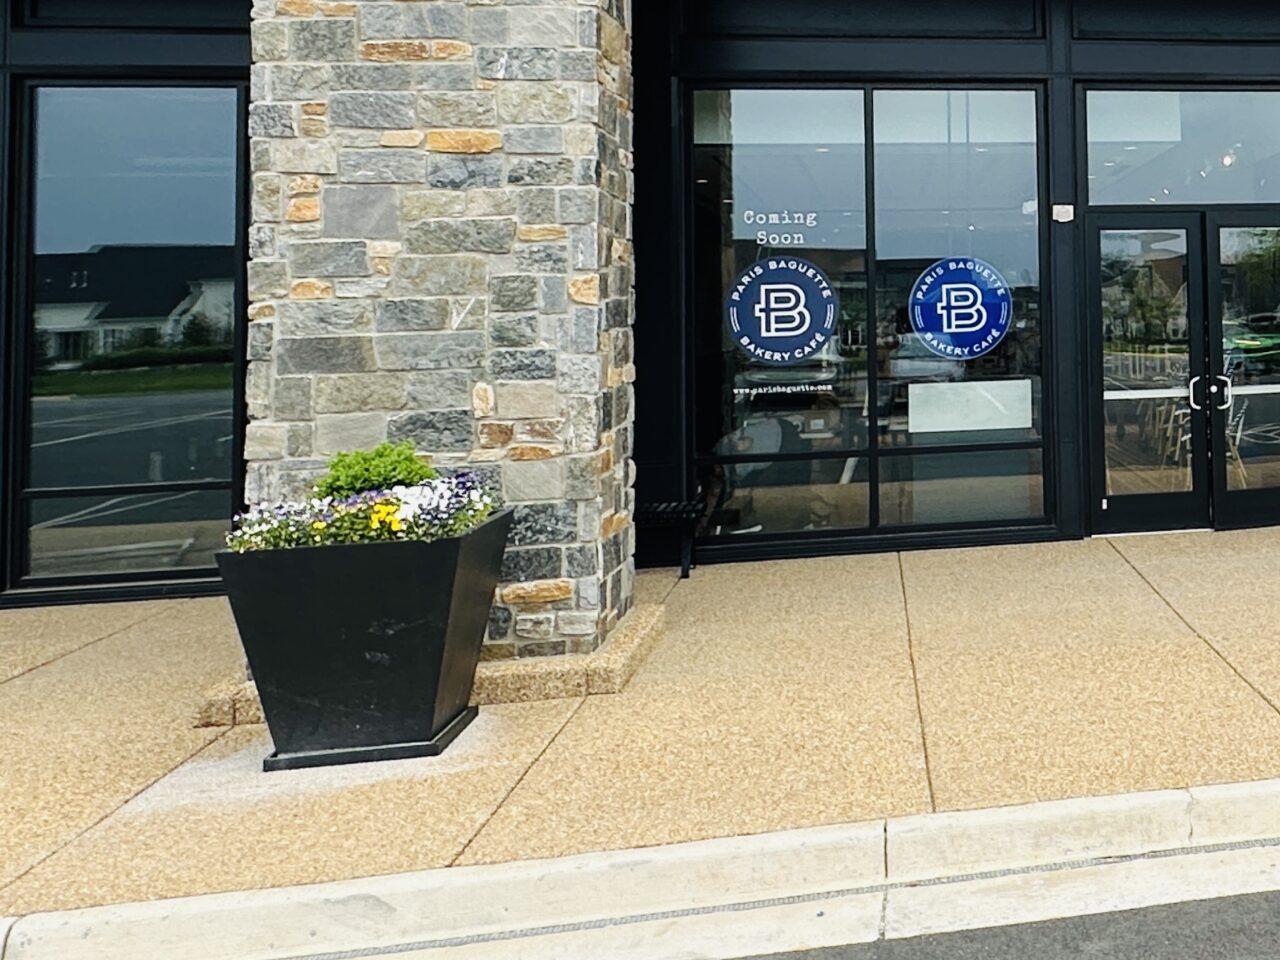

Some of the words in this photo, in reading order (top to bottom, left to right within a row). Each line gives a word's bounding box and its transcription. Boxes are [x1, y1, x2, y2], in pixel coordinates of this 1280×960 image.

[743, 209, 818, 227] Coming
[756, 230, 805, 246] Soon
[731, 264, 764, 302] PARIS
[768, 259, 832, 300] BAGUETTE
[915, 265, 945, 300] PARIS
[948, 260, 1007, 298] BAGUETTE
[739, 334, 792, 362] BAKERY
[924, 331, 971, 356] BAKERY
